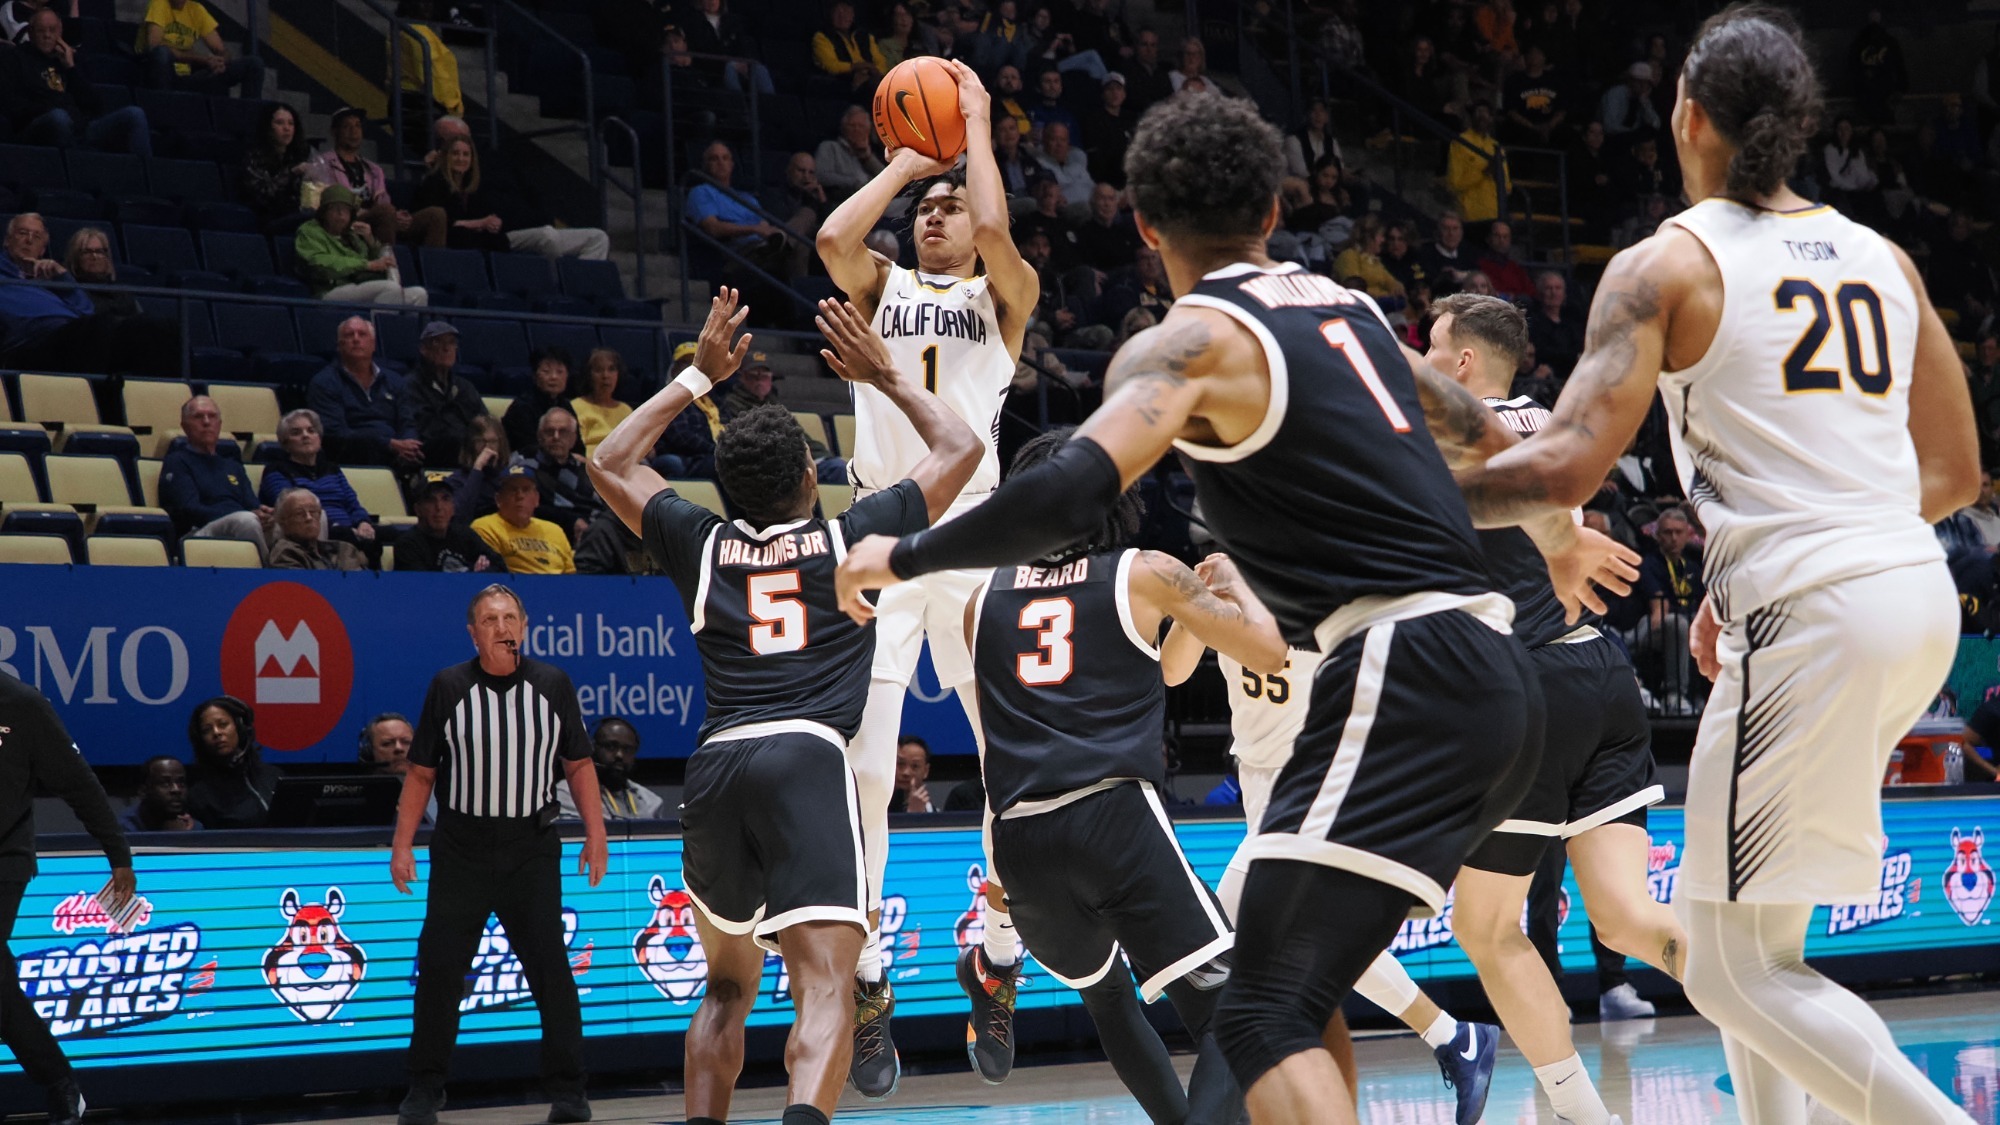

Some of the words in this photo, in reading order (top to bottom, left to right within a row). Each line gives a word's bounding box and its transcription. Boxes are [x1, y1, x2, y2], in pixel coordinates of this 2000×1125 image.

[1782, 239, 1841, 261] TYSON
[881, 302, 987, 346] CALIFORNIA
[1771, 276, 1894, 398] 20
[921, 344, 939, 396] 1
[1318, 317, 1412, 433] 1
[718, 534, 799, 567] HALLUMS
[799, 530, 828, 557] JR
[1013, 557, 1090, 590] BEARD
[524, 613, 584, 657] icial
[596, 613, 677, 657] bank
[747, 569, 808, 656] 5
[1016, 596, 1076, 688] 3
[576, 672, 694, 727] erkeley
[1241, 660, 1291, 705] 55
[1827, 884, 1905, 935] FLAKES
[18, 926, 199, 997] FROSTED
[33, 973, 183, 1036] FLAKES
